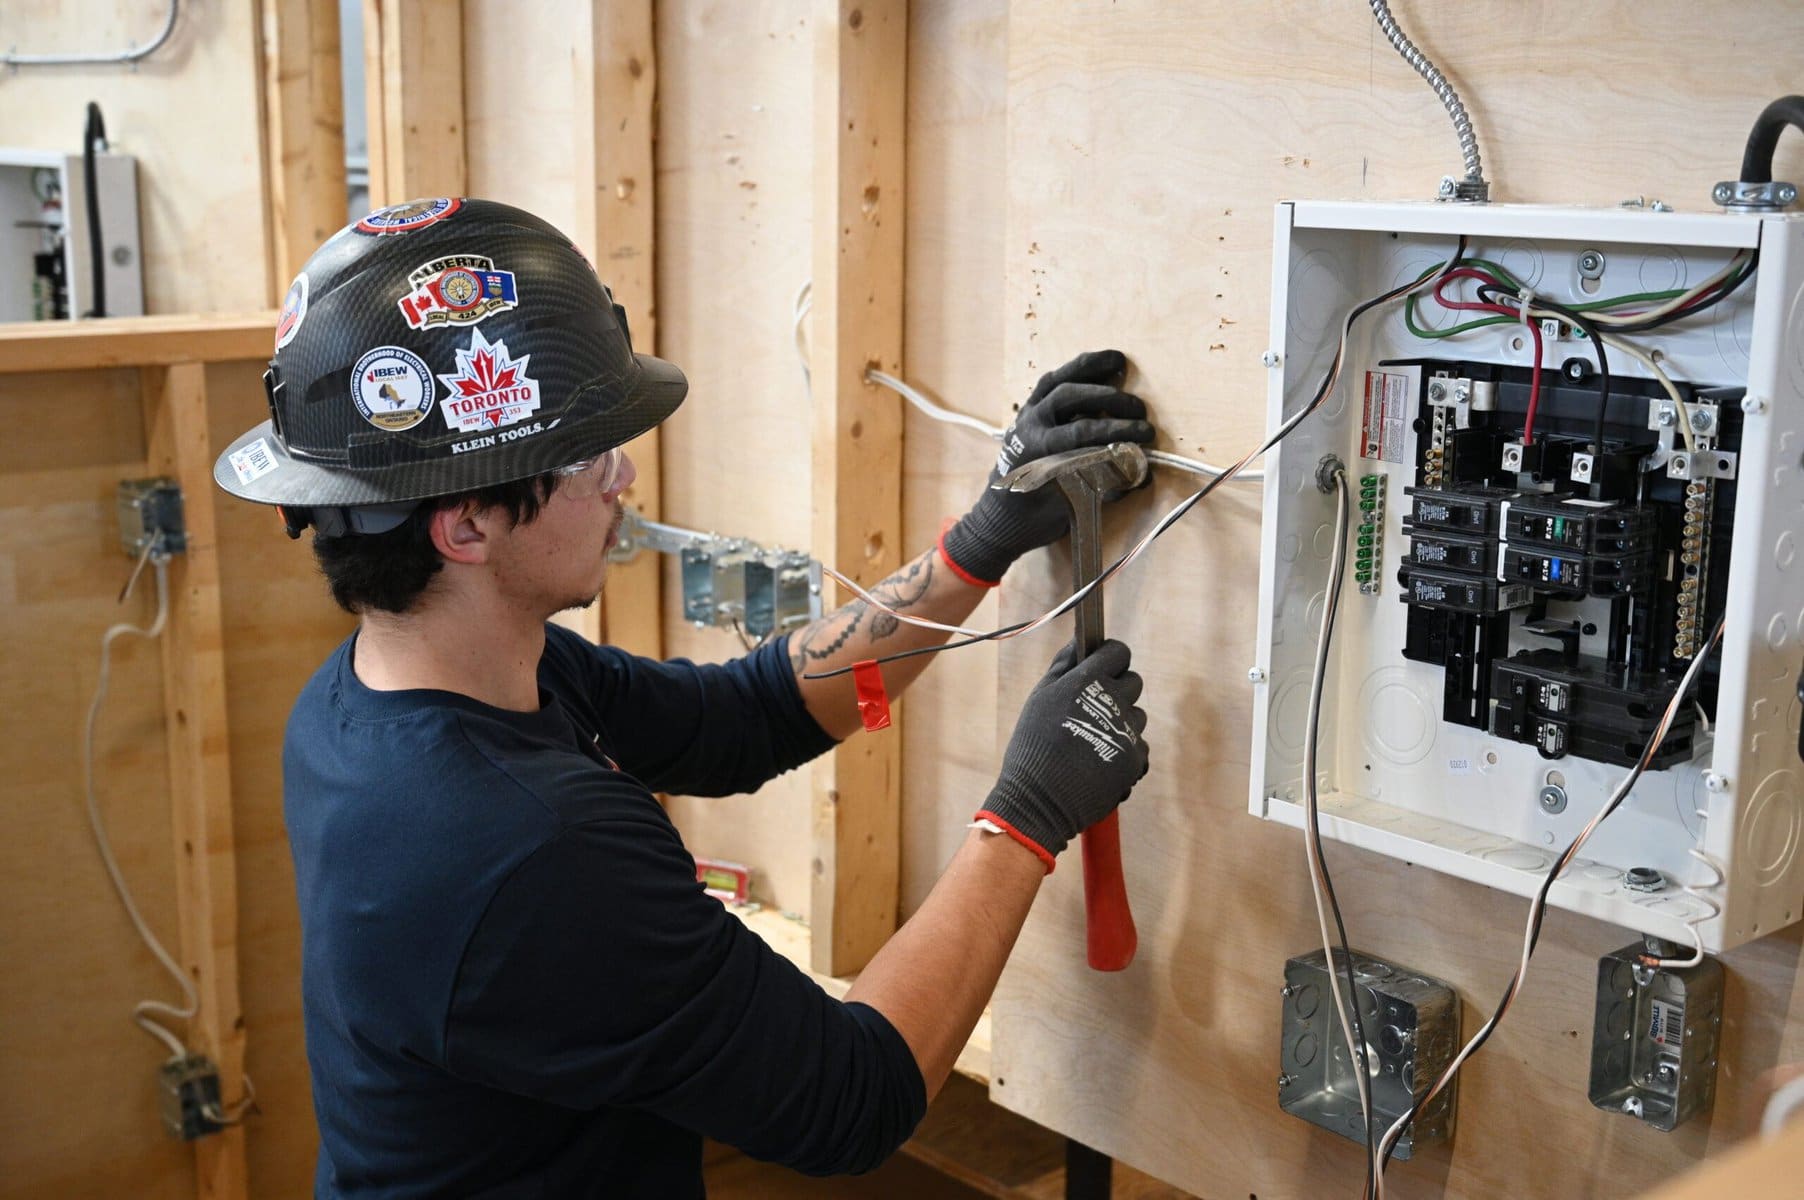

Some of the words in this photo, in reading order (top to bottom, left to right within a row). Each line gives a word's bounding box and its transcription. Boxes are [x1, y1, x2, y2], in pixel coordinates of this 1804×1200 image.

[410, 257, 491, 284] ALBERTA
[458, 311, 478, 320] 424
[374, 366, 408, 378] IBEW
[449, 387, 532, 417] TORONTO
[451, 435, 497, 455] KLEIN
[249, 449, 270, 471] IBEW
[1061, 720, 1119, 762] Milwaukee
